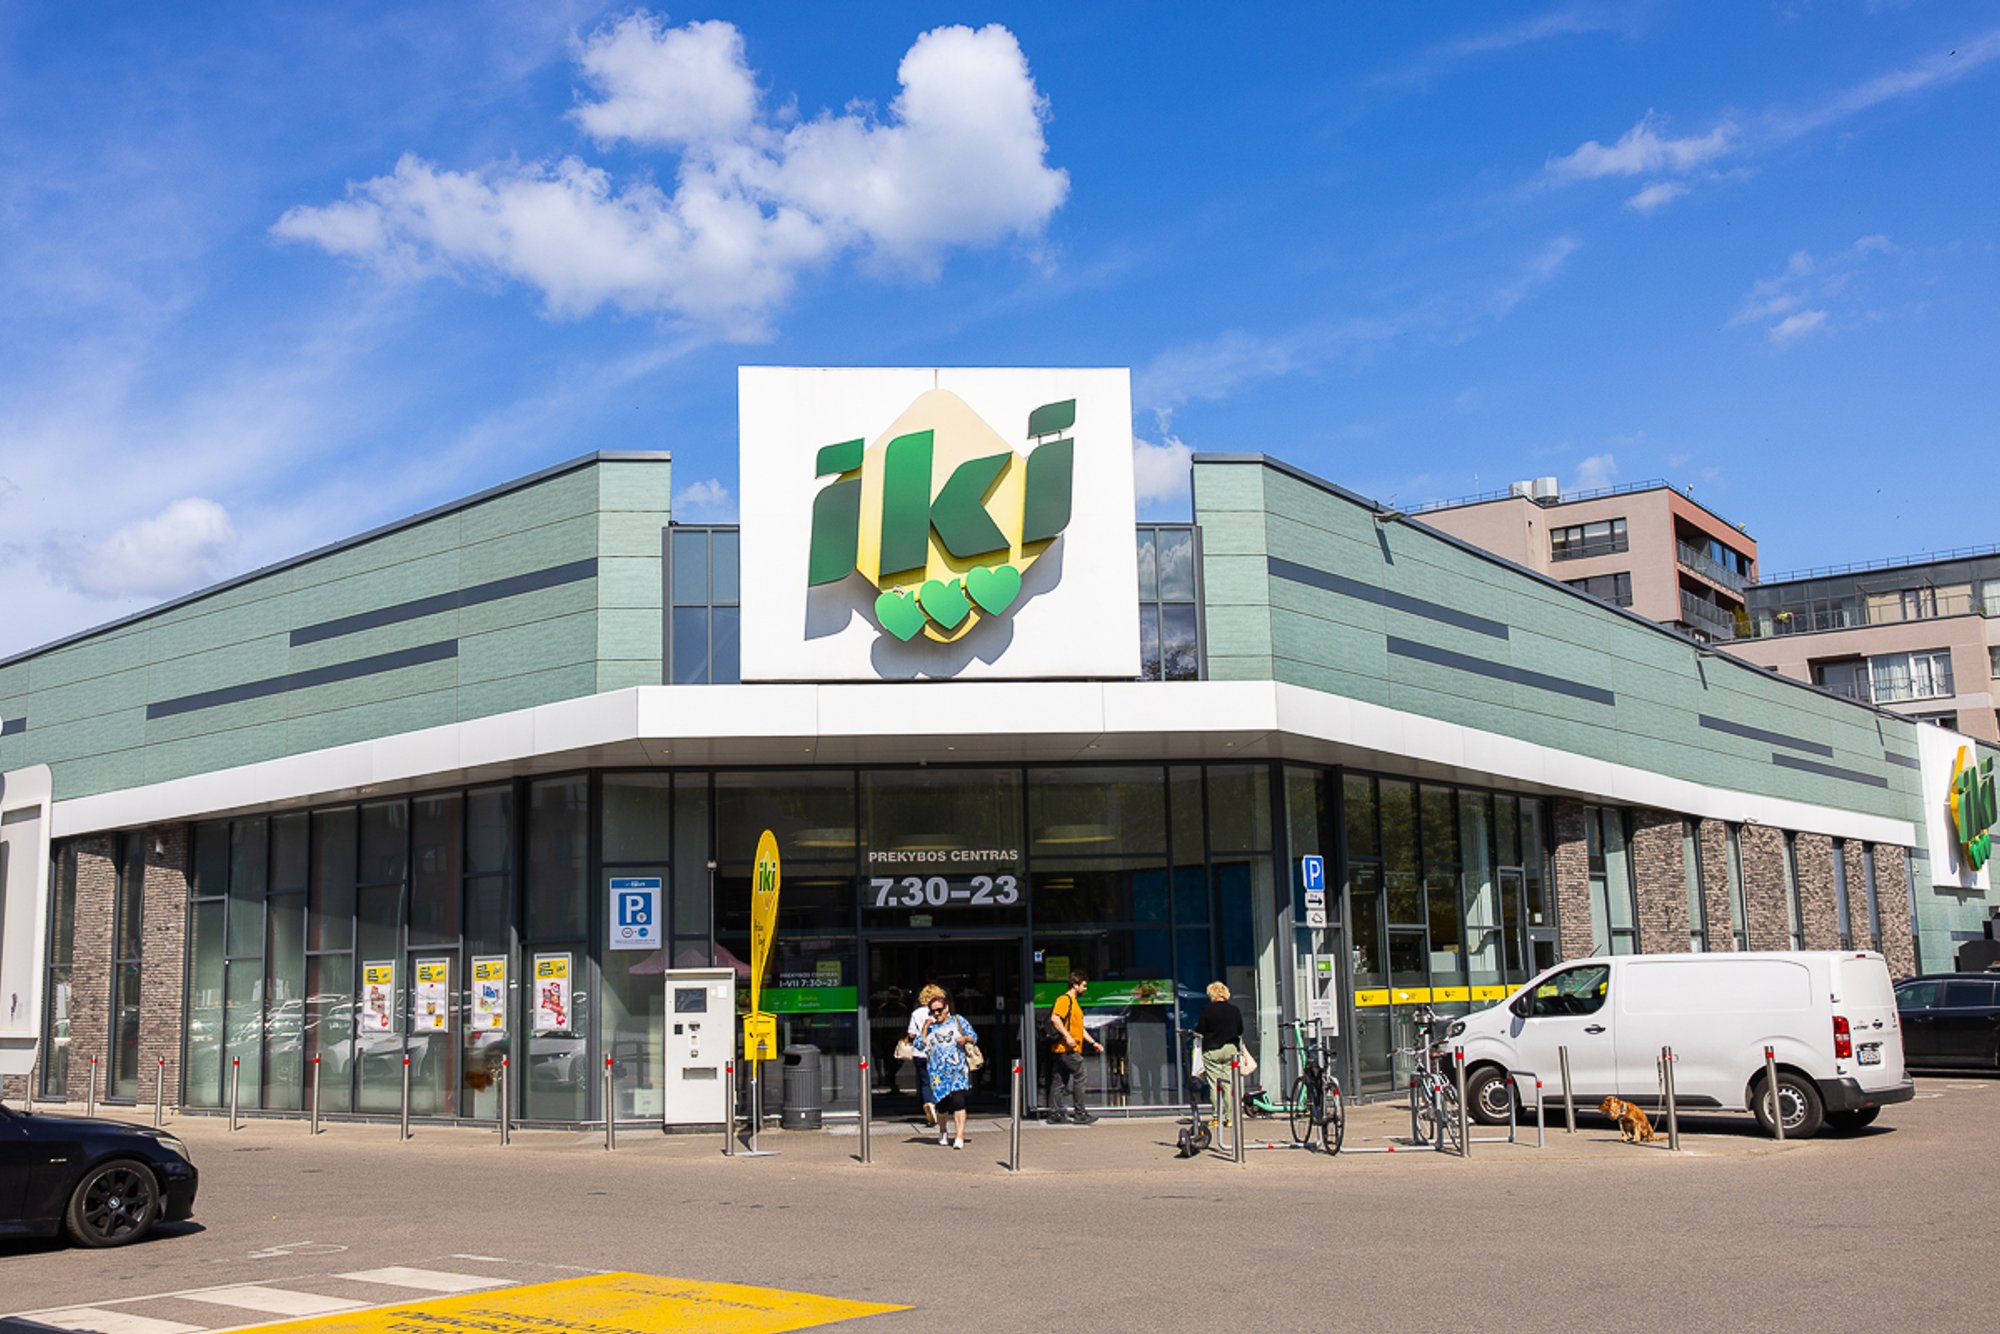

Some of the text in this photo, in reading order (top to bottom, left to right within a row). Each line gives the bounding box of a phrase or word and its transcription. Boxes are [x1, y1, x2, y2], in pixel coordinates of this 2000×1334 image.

[808, 398, 1076, 588] iki
[1957, 755, 1999, 844] iki
[868, 849, 1019, 863] PREKYBOS CENTRAS
[758, 859, 776, 893] iki
[1309, 860, 1320, 887] P
[870, 875, 1019, 907] 7.30–23
[625, 895, 645, 924] P
